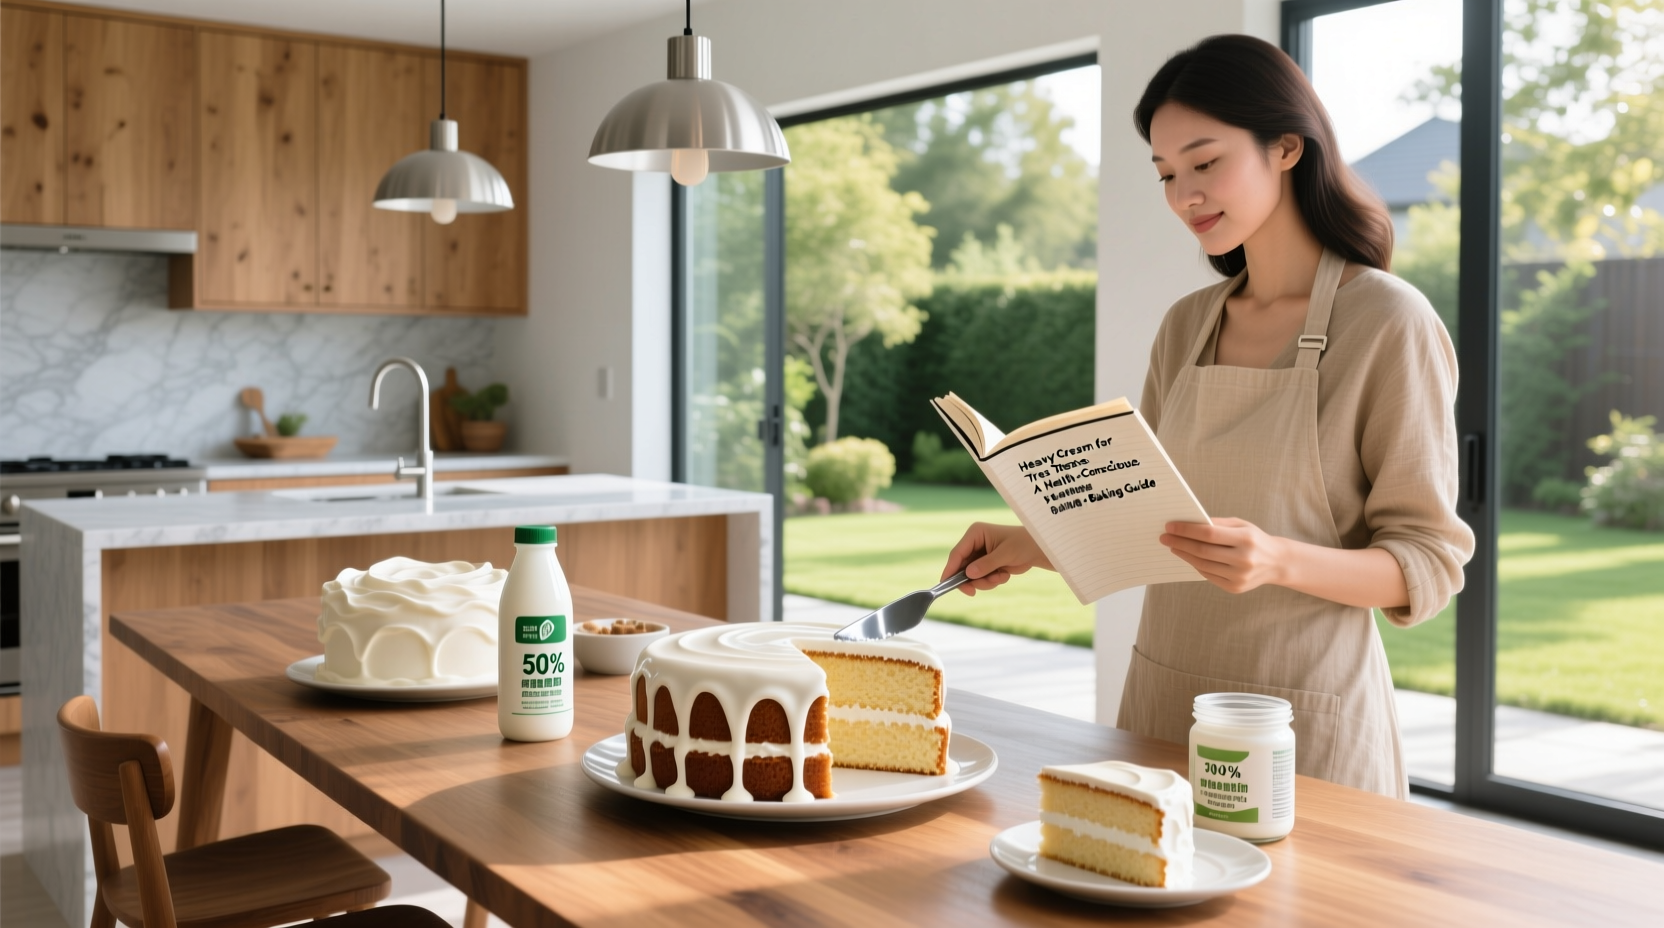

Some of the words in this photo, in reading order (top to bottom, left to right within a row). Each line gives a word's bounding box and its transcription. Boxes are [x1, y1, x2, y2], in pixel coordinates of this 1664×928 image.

[1018, 453, 1055, 472] Heavy
[1095, 437, 1113, 449] for
[522, 652, 565, 675] 50%
